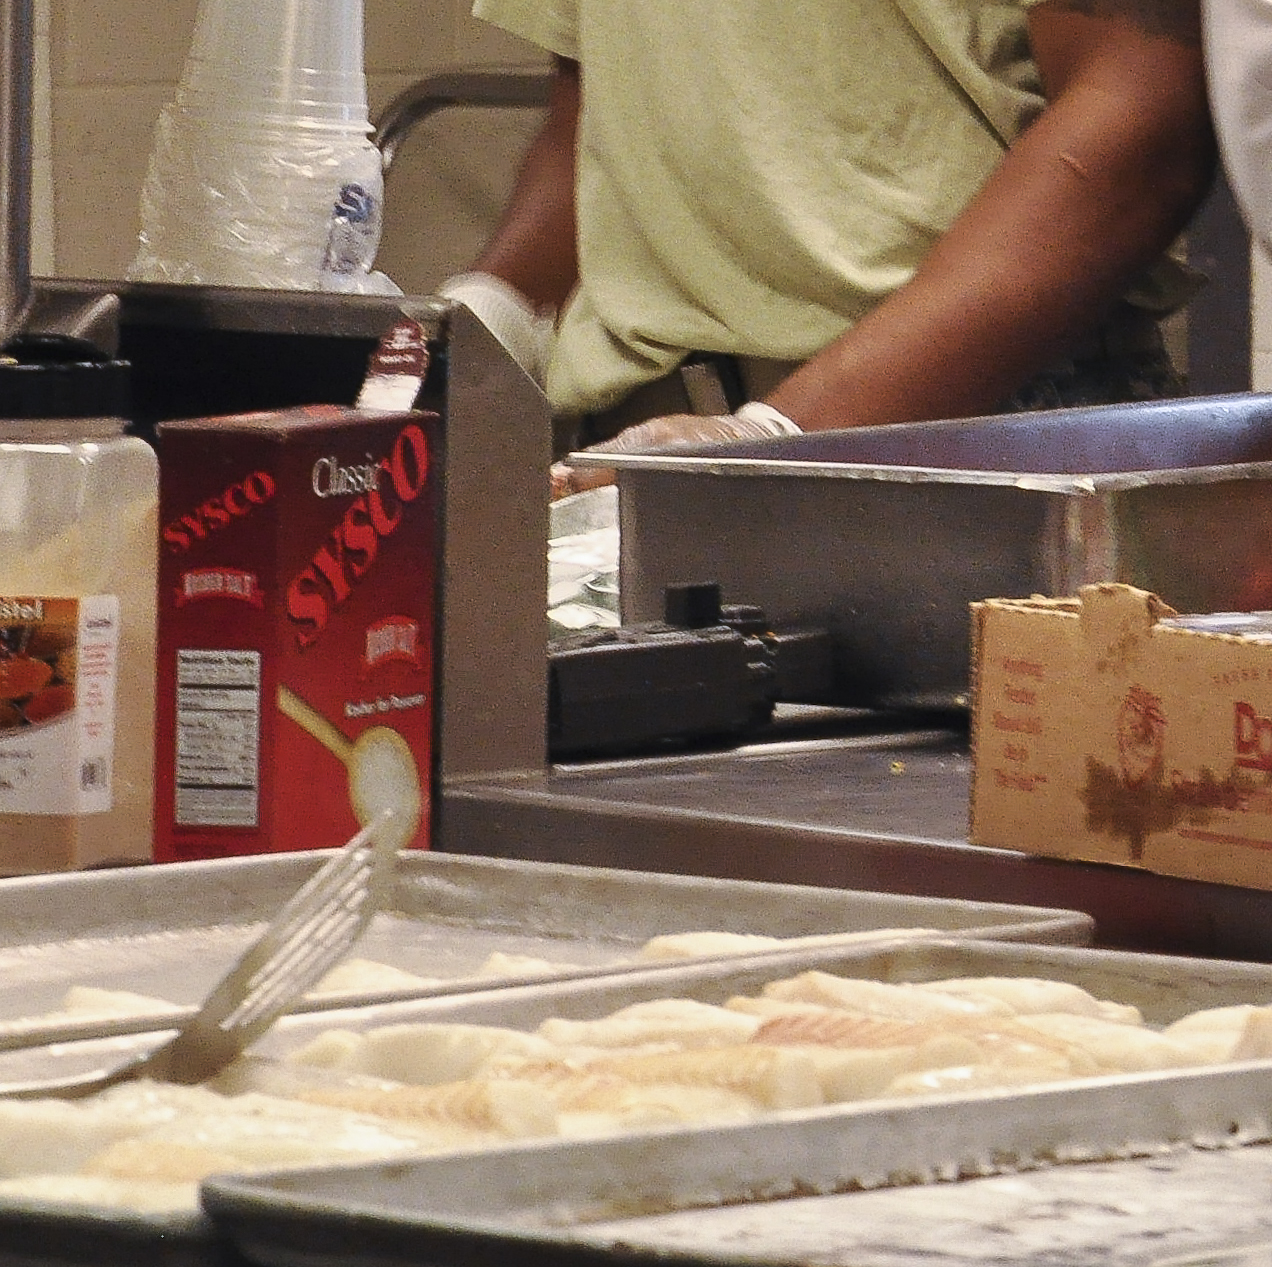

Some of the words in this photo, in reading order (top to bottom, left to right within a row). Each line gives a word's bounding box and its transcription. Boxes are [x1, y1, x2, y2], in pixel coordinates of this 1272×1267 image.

[163, 471, 277, 553] SYSCO
[312, 452, 382, 499] Classic
[287, 424, 429, 646] SYSCO
